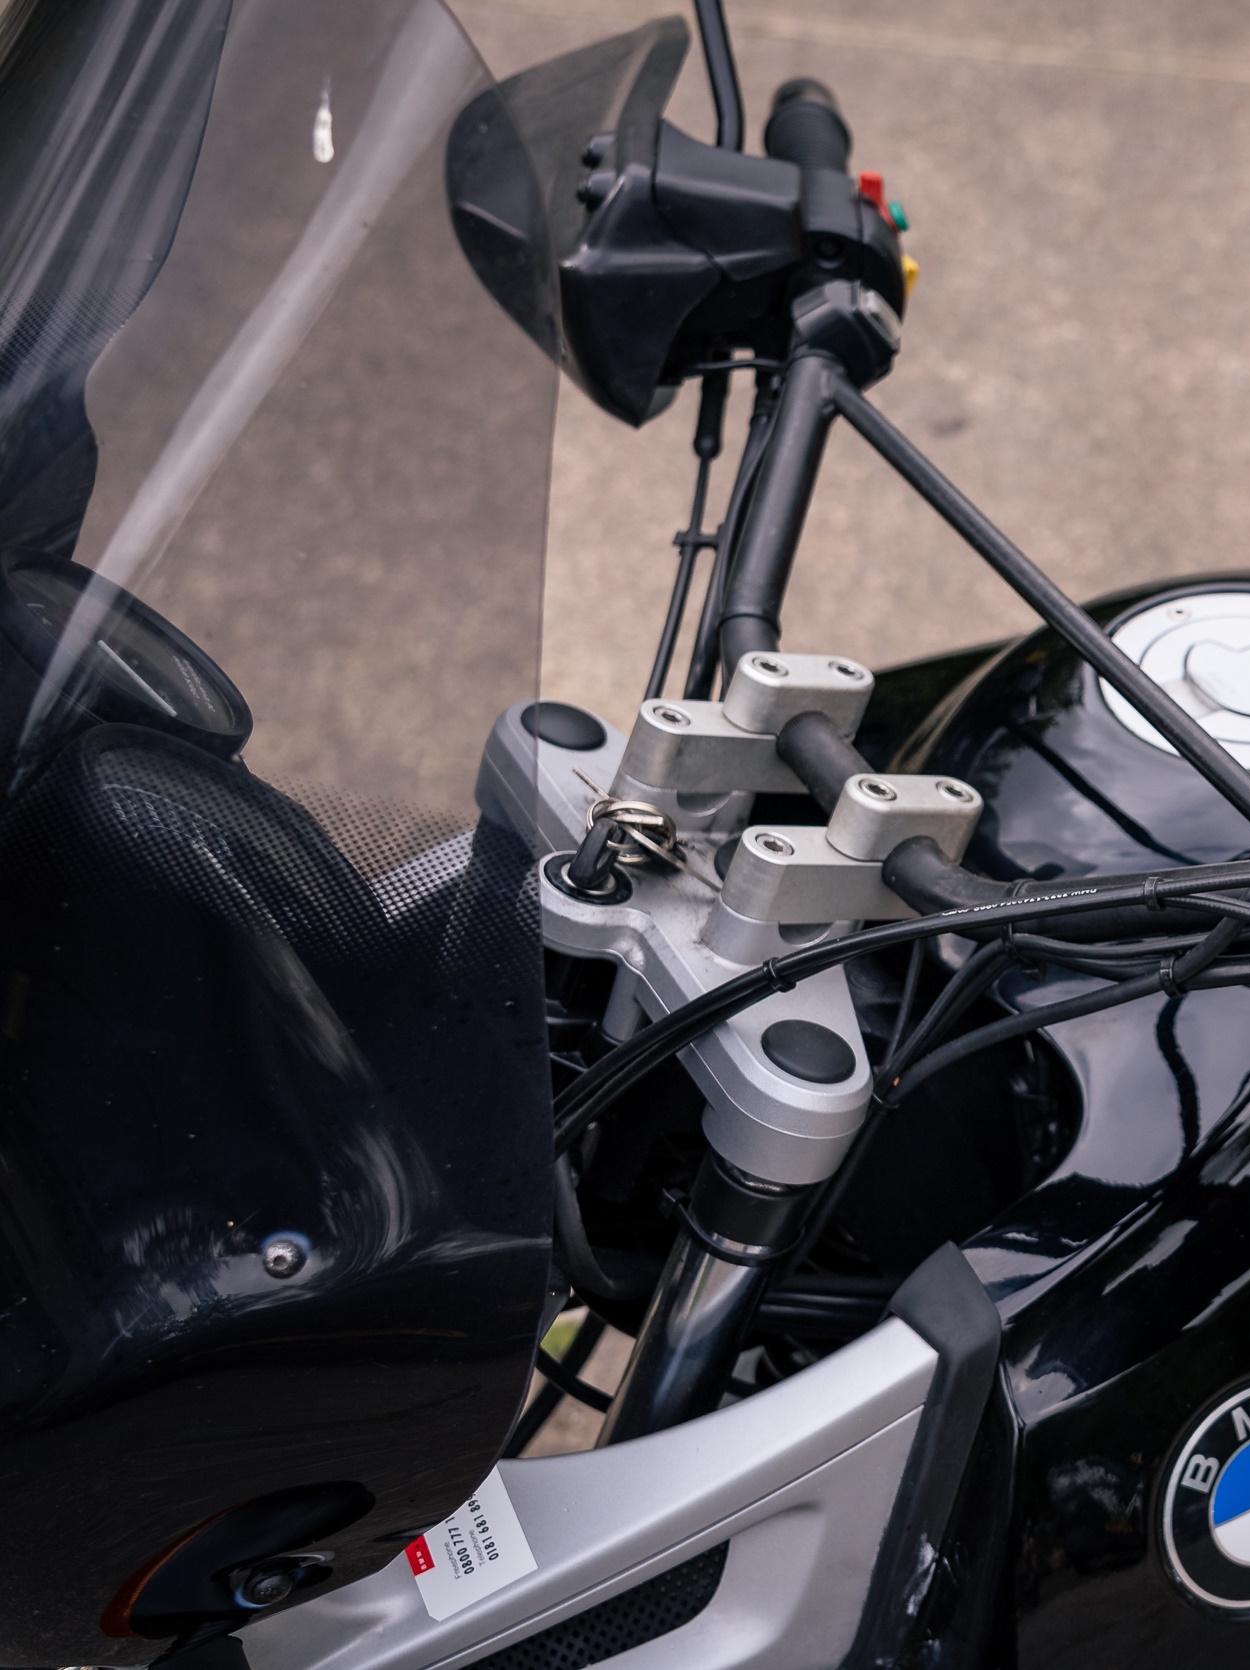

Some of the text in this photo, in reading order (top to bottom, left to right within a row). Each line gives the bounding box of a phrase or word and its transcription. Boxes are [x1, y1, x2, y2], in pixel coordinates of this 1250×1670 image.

[448, 1527, 465, 1547] 777
[473, 1514, 489, 1534] 681
[444, 1541, 462, 1580] Freephone
[457, 1547, 475, 1575] 0800
[469, 1529, 486, 1567] Telephone
[482, 1536, 499, 1561] 0181
